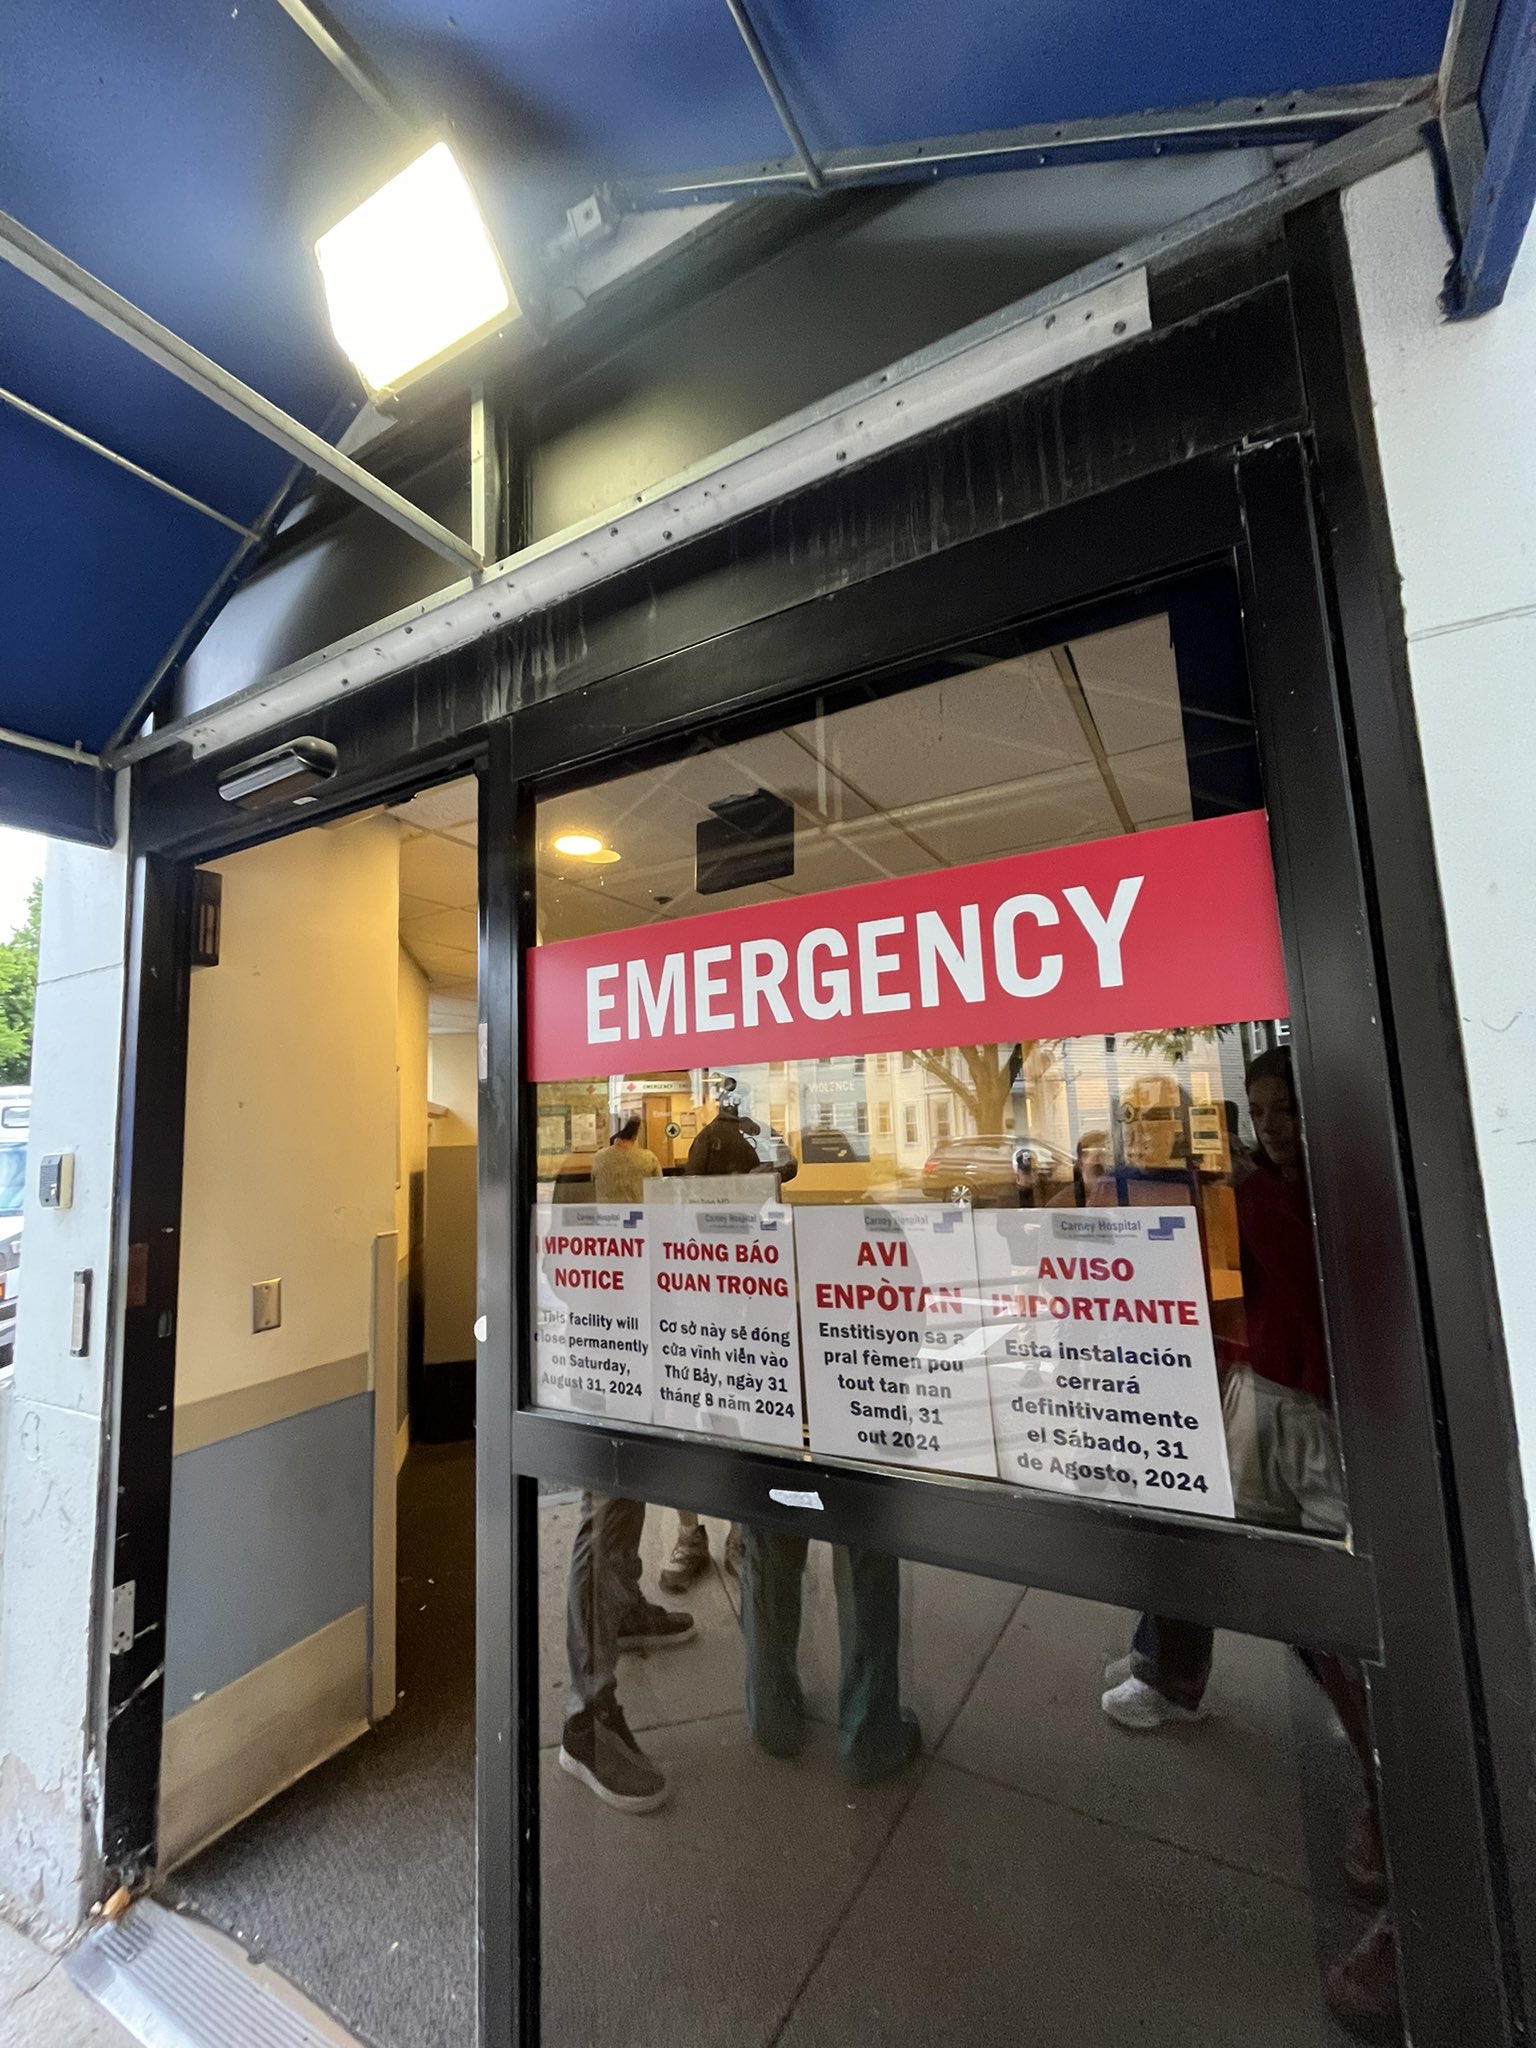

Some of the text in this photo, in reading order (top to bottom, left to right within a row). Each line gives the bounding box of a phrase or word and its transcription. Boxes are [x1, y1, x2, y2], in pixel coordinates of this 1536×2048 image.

[585, 875, 1145, 1045] EMERGENCY
[808, 1081, 856, 1093] VIOLENCE
[864, 1215, 892, 1227] Carney
[1060, 1220, 1142, 1233] Carney Hospital
[662, 1238, 779, 1264] THÔNG BÁO
[857, 1241, 908, 1267] AVI
[555, 1268, 624, 1290] NOTICE
[1038, 1257, 1135, 1282] AVISO
[656, 1272, 789, 1300] QUAN TRỌNG
[816, 1277, 963, 1314] ENPÒTAN
[543, 1310, 639, 1331] This facility will
[659, 1319, 677, 1333] Cơ
[680, 1321, 697, 1335] sở
[700, 1322, 726, 1341] này
[751, 1326, 791, 1347] đóng
[819, 1322, 920, 1344] Enstitisyon
[925, 1330, 947, 1344] sa
[569, 1336, 649, 1356] permanently
[662, 1342, 687, 1356] cửa
[691, 1345, 721, 1361] vĩnh
[760, 1351, 789, 1368] vào
[1004, 1338, 1193, 1368] Esta instalación
[552, 1354, 631, 1376] on Saturday,
[824, 1349, 964, 1373] pral fèmen pou
[542, 1371, 643, 1397] August 31, 2024
[664, 1364, 788, 1393] Thứ Bảy, ngày 31
[838, 1374, 952, 1399] tout tan nan
[1056, 1374, 1141, 1394] cerrará
[659, 1386, 795, 1418] tháng 8 năm 2024
[850, 1400, 943, 1425] Samdi, 31
[1011, 1396, 1199, 1430] definitivamente
[857, 1429, 941, 1451] out 2024
[1027, 1427, 1189, 1460] el Sábado, 31
[1016, 1453, 1209, 1494] de Agosto, 2024
